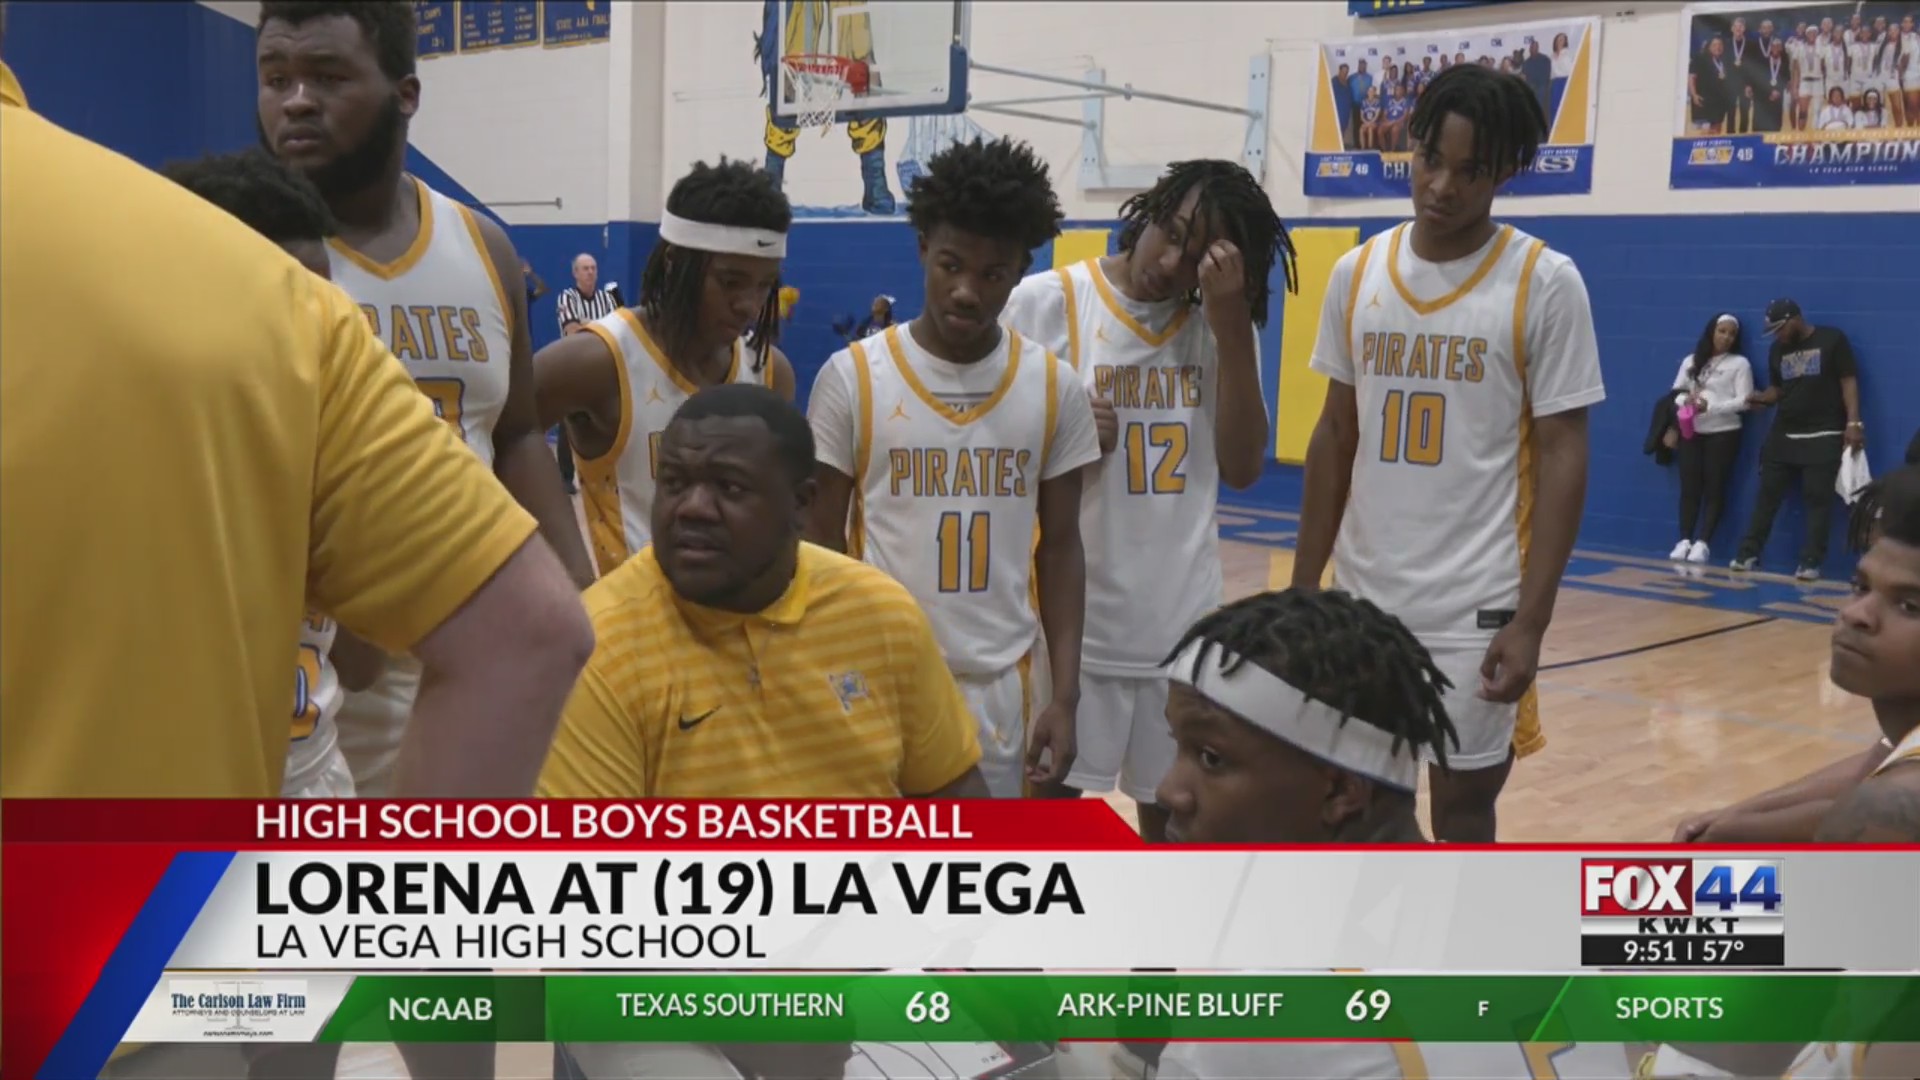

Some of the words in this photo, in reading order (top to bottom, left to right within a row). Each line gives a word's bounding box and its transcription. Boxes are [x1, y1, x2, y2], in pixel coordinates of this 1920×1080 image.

[1094, 365, 1203, 409] PIRATE
[1363, 332, 1488, 383] PIRATES
[1124, 421, 1188, 495] 12
[1380, 389, 1446, 467] 10
[889, 447, 1030, 497] PIRATES
[936, 511, 990, 593] 11
